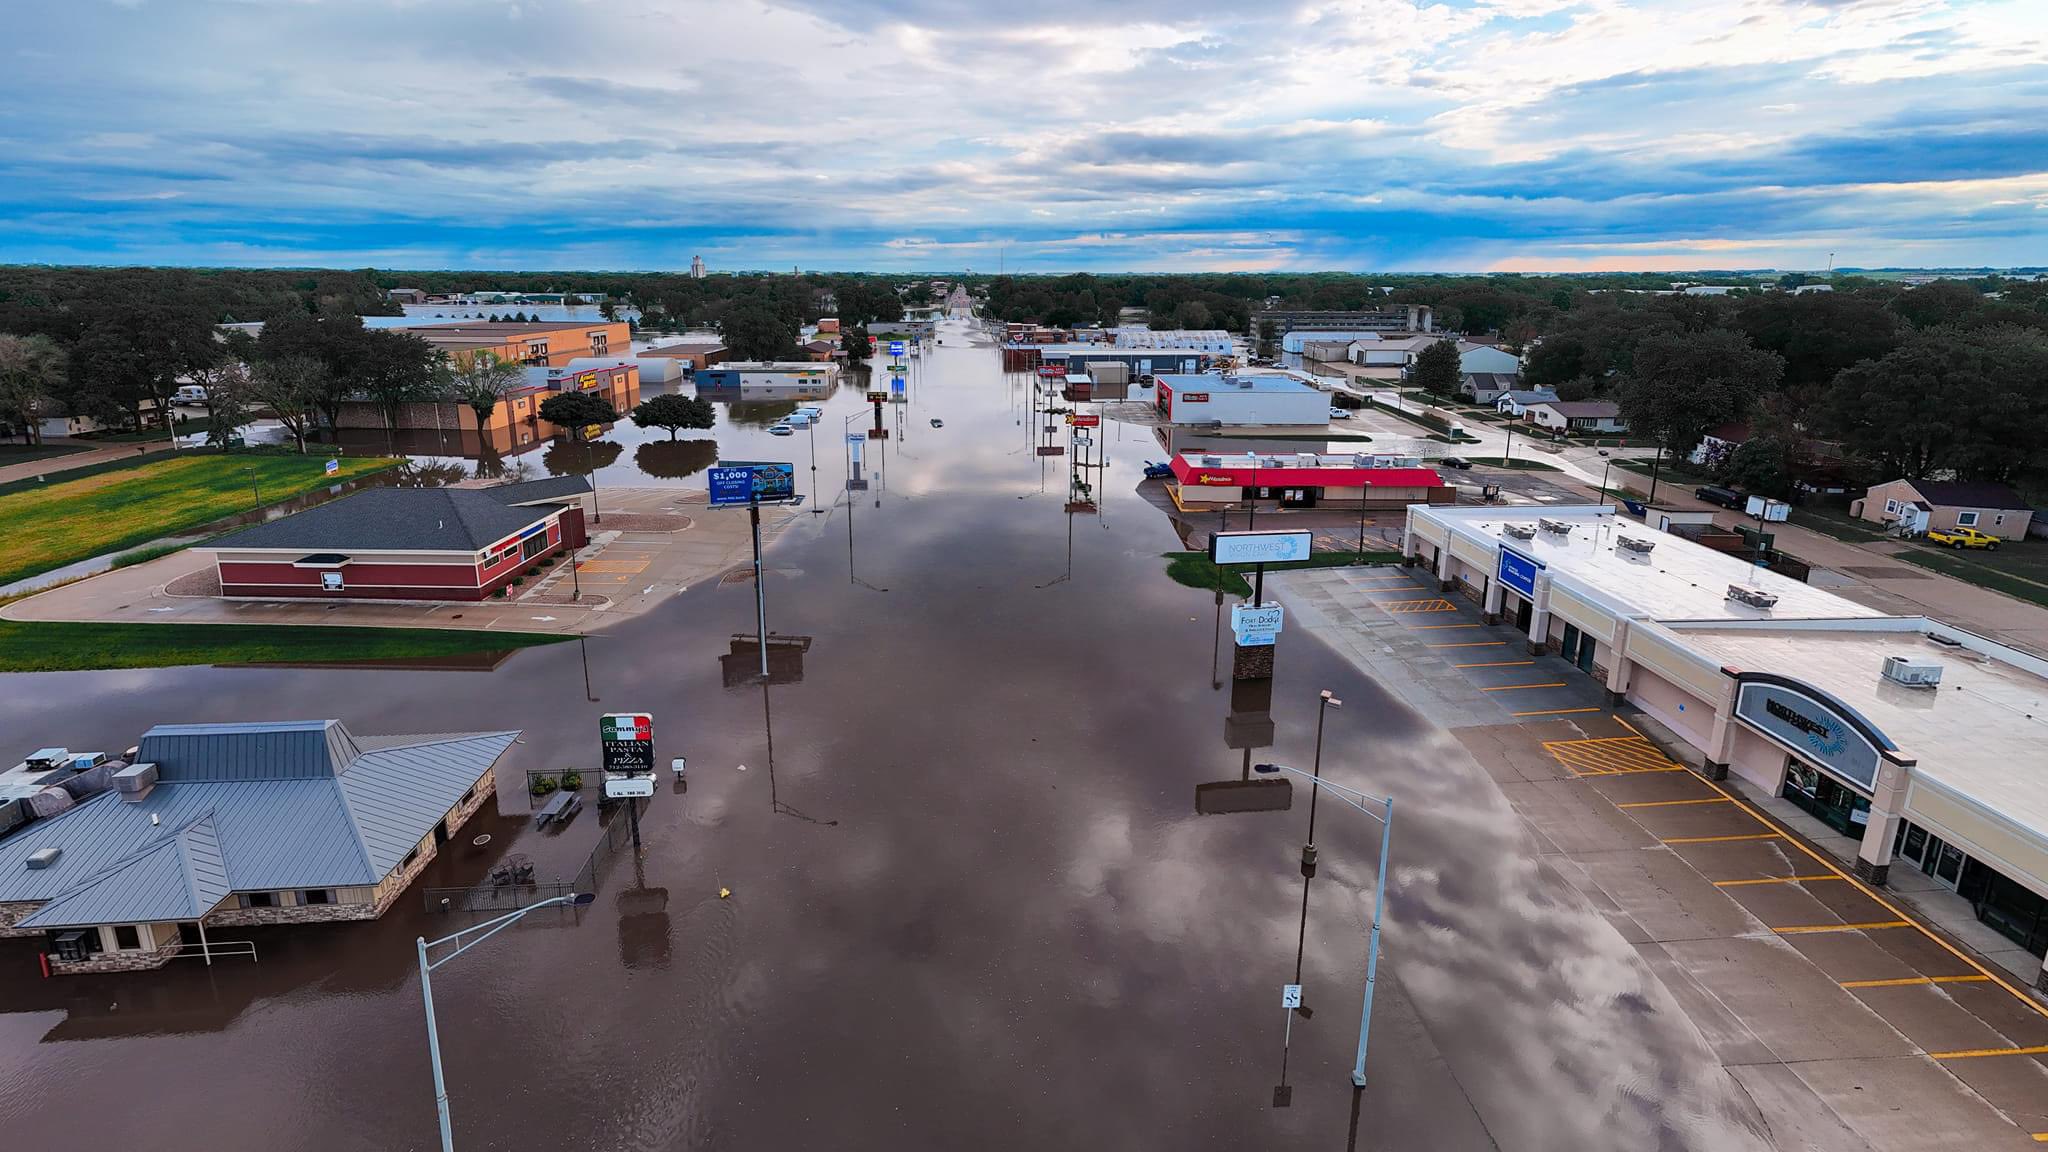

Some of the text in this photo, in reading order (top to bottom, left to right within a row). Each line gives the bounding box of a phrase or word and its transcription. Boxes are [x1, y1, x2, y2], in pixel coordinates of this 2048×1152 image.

[713, 471, 748, 481] $1,000
[1229, 543, 1285, 553] NORTHWEST
[1258, 616, 1280, 625] Dodge
[1766, 698, 1829, 738] NORTHWEST
[603, 725, 649, 734] Sammy's
